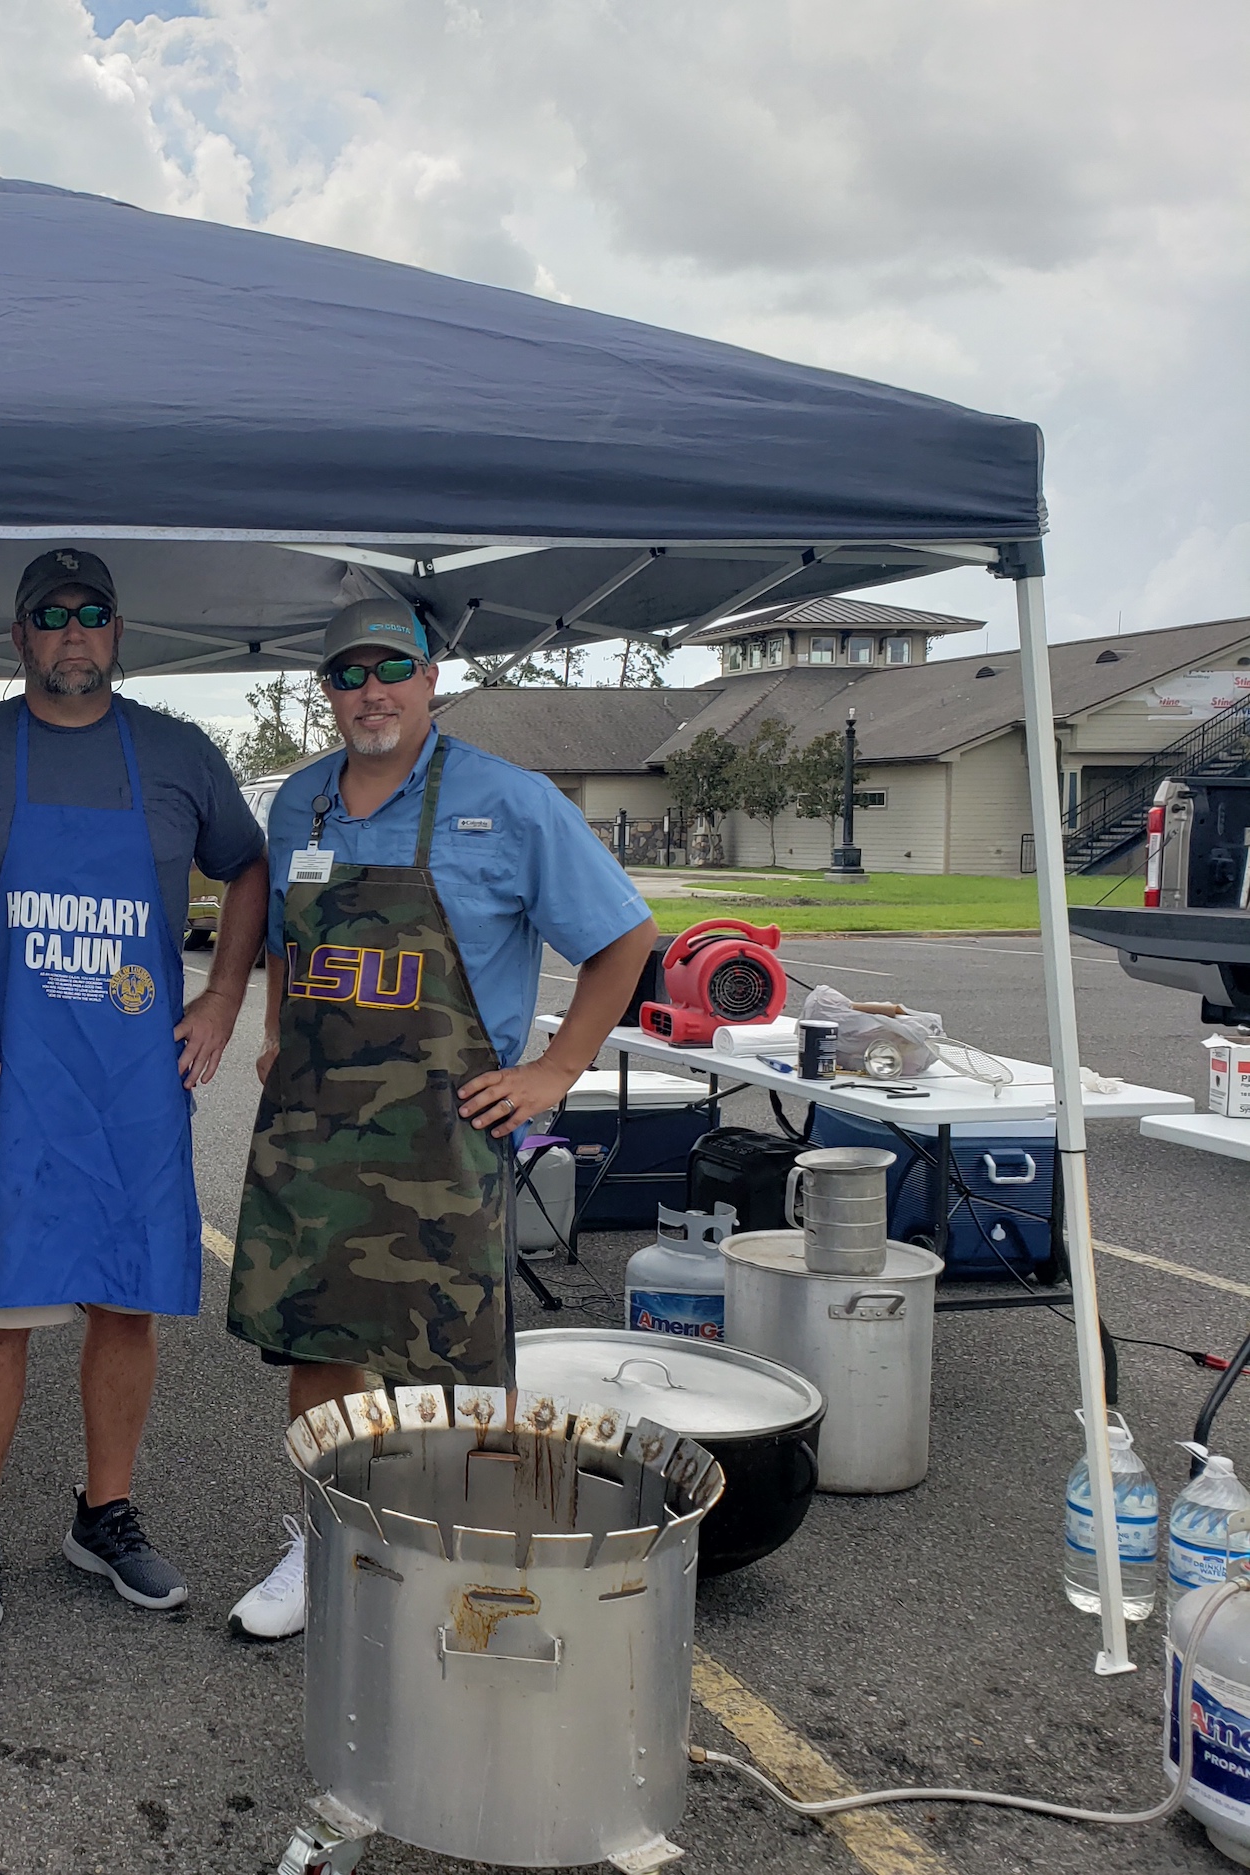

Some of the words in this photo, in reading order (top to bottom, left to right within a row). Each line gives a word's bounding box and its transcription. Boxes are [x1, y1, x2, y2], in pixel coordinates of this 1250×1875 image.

[56, 552, 79, 570] LSU
[384, 623, 411, 635] COSTA
[1159, 697, 1180, 706] tine
[6, 890, 150, 938] HONORARY
[25, 931, 123, 976] CAJUN
[286, 942, 424, 1009] LSU
